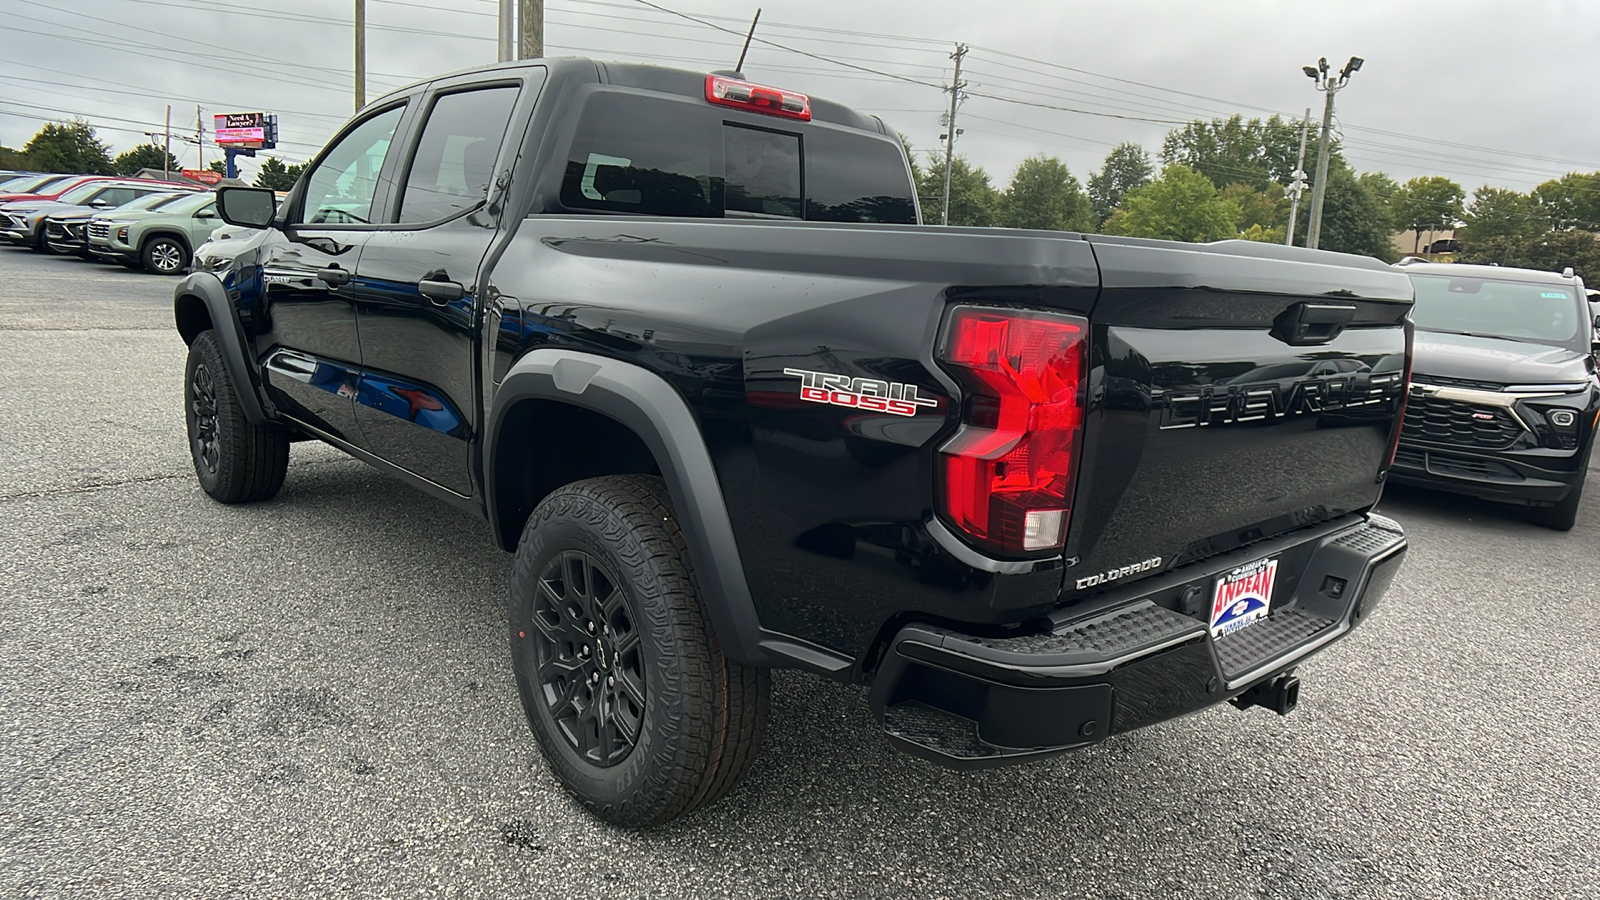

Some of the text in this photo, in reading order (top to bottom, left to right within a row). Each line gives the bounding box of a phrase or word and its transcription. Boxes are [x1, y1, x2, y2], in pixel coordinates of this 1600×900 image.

[783, 367, 938, 408] TRAIL
[800, 386, 917, 417] BOSS
[1076, 556, 1162, 590] COLORADO
[1212, 566, 1274, 623] ANDEAN
